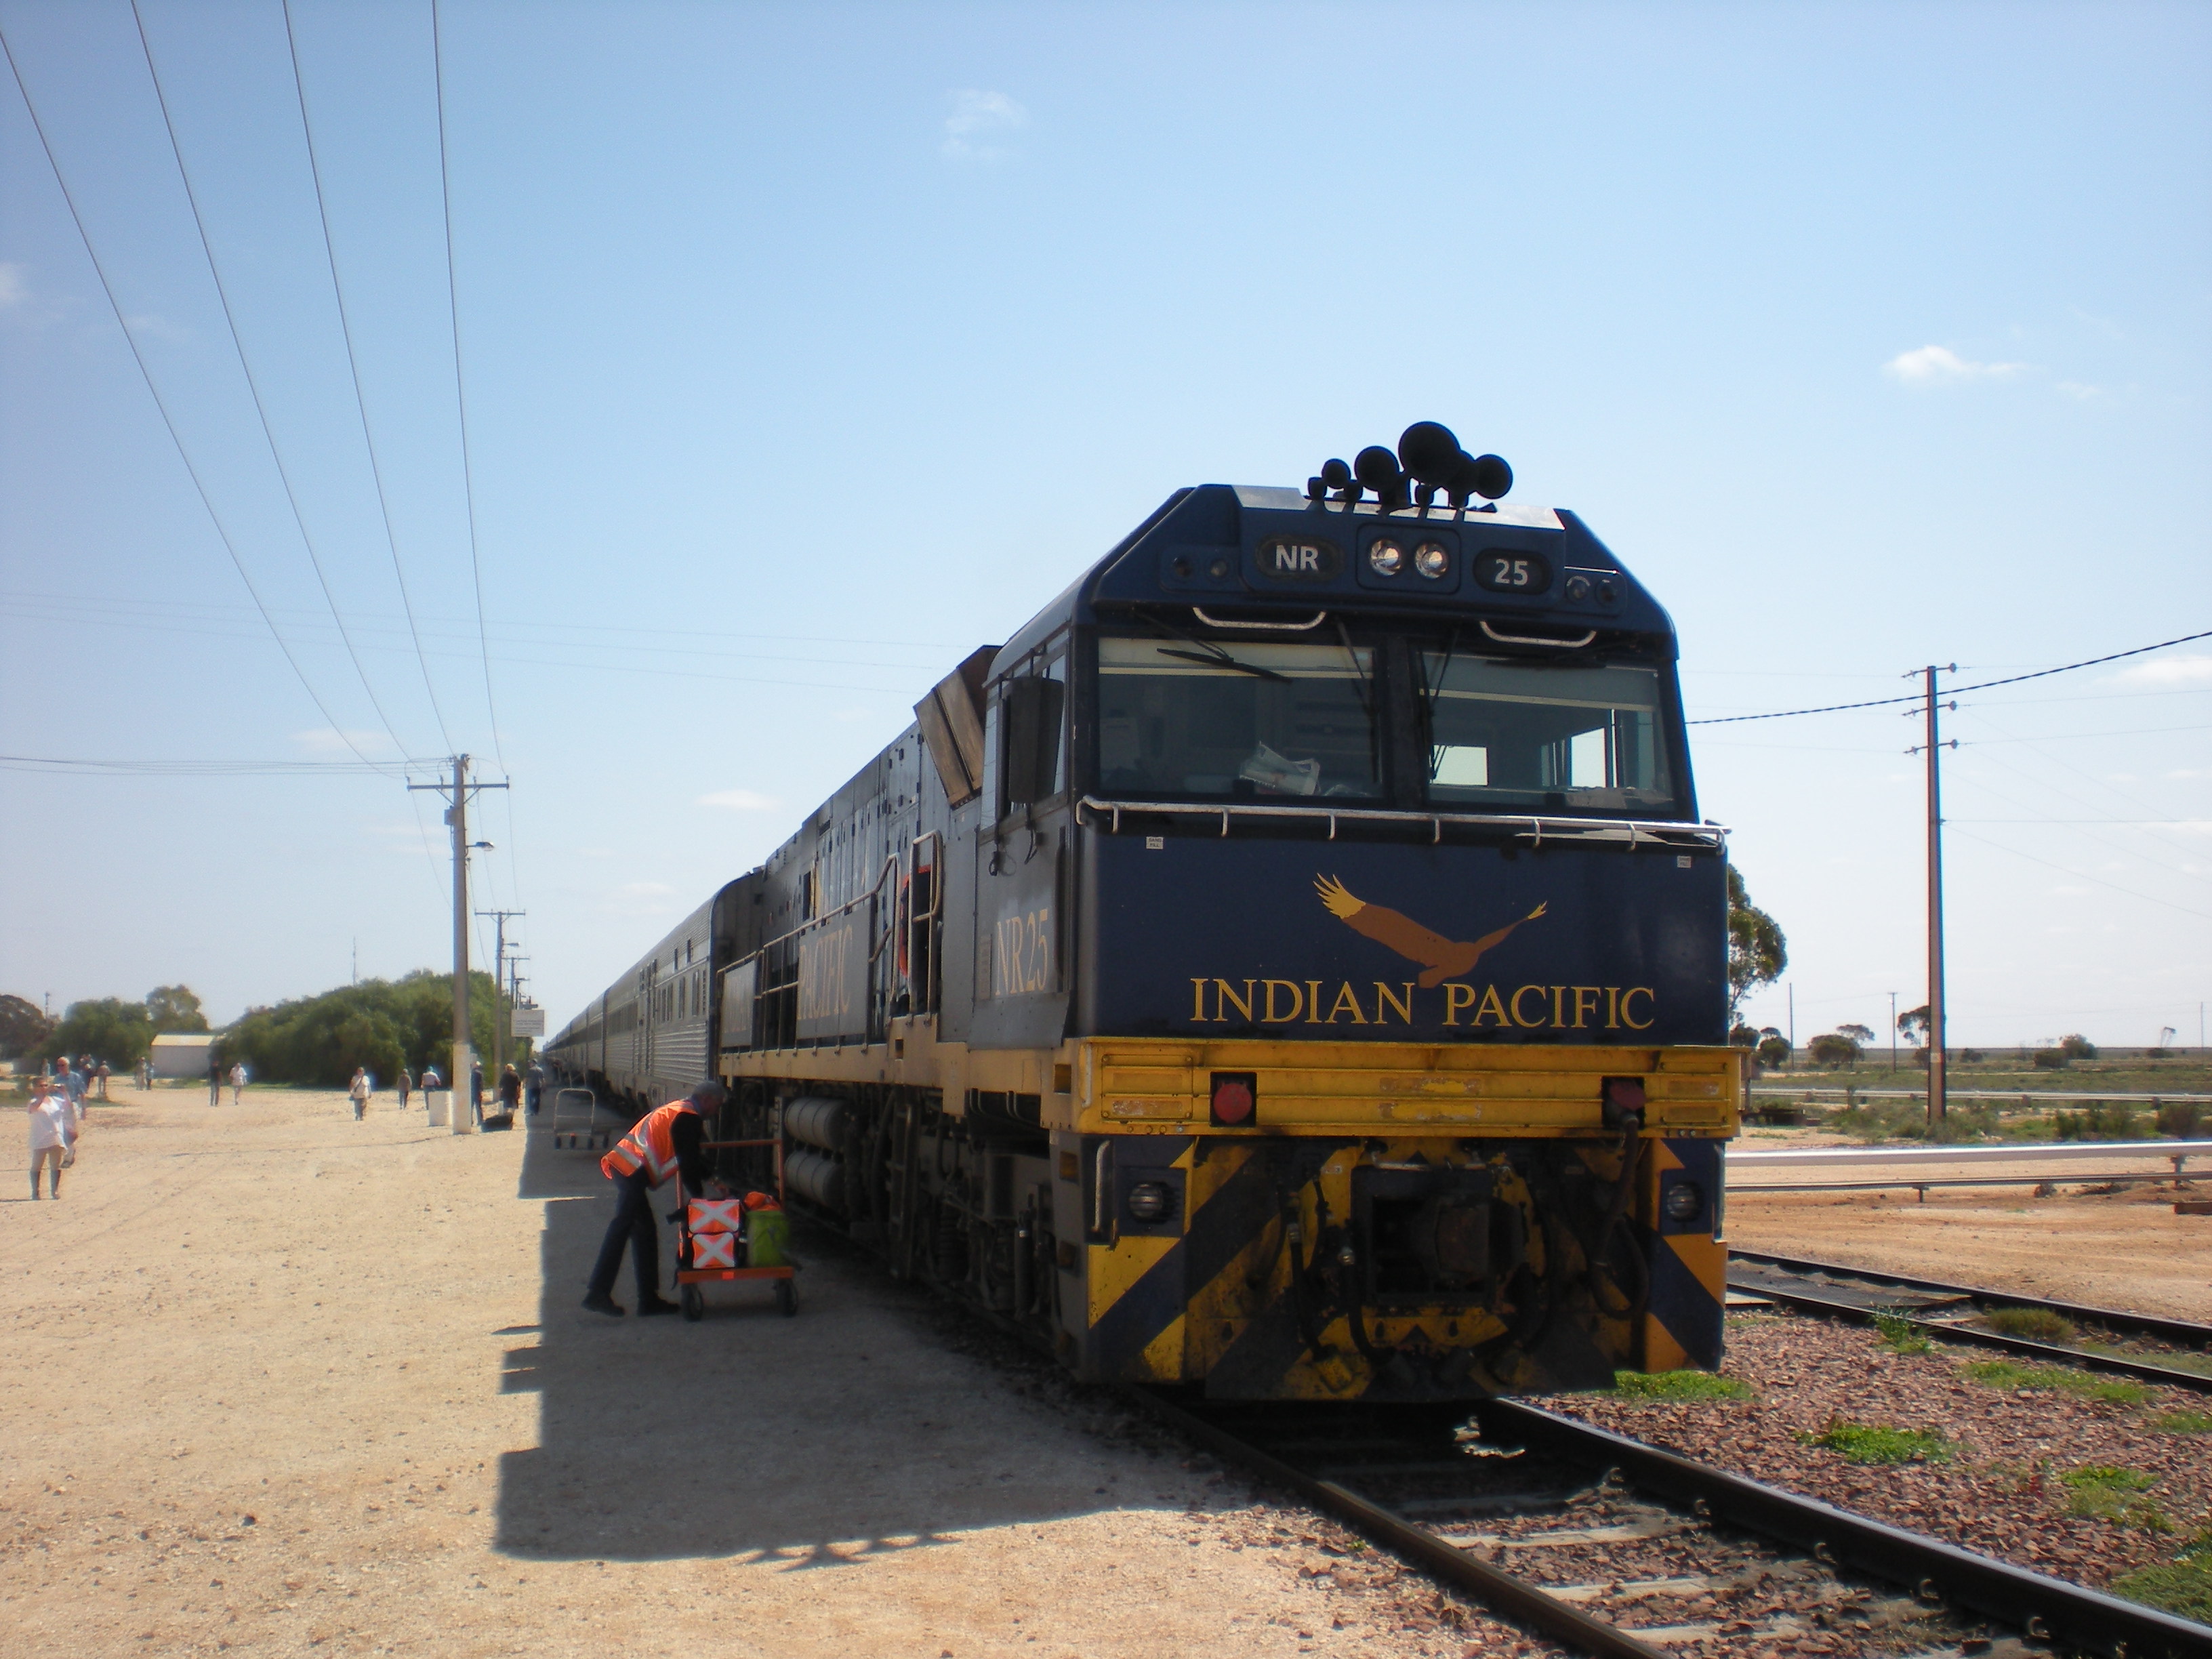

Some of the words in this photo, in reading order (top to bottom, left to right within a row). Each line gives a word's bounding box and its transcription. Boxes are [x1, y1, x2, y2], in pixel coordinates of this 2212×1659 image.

[1275, 544, 1319, 571] NR
[1495, 558, 1528, 586] 25
[796, 924, 853, 1020] PACIFIC
[1189, 978, 1416, 1025] INDIAN
[1442, 983, 1654, 1029] PACIFIC
